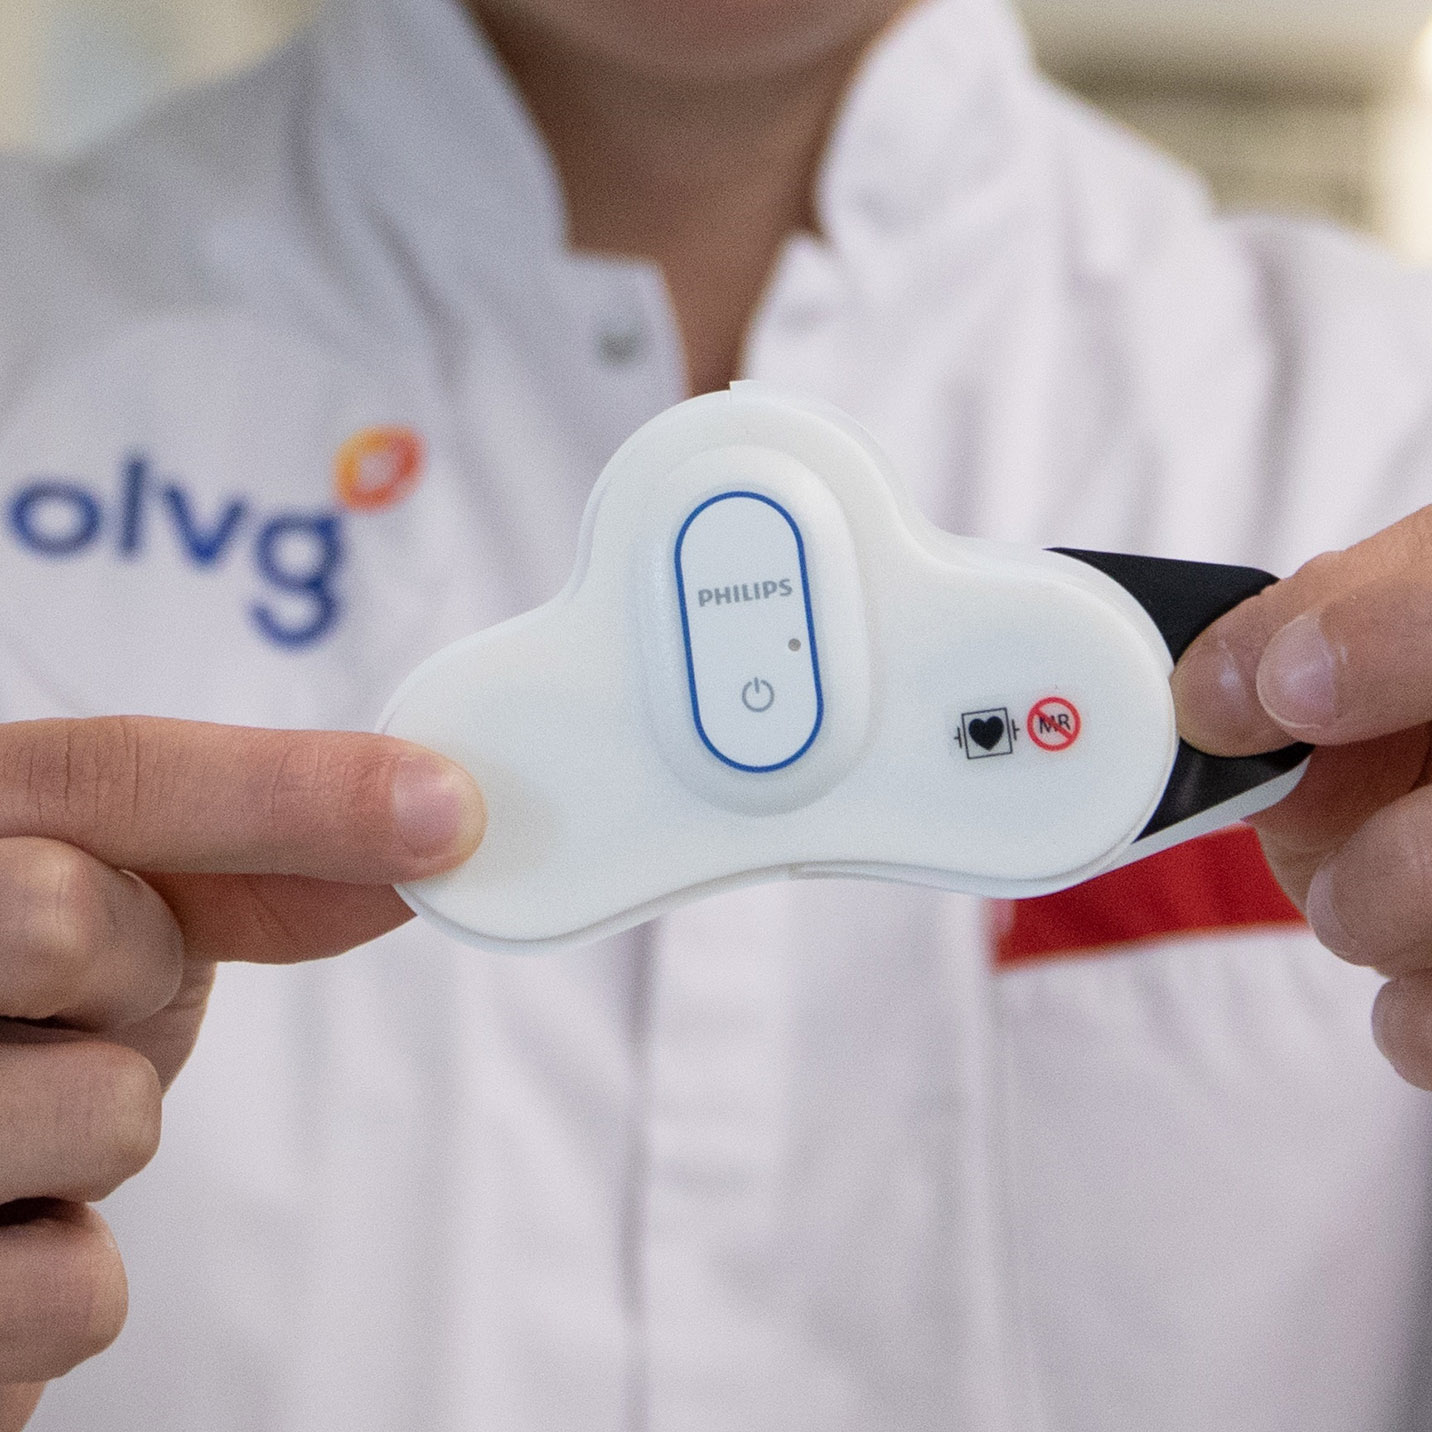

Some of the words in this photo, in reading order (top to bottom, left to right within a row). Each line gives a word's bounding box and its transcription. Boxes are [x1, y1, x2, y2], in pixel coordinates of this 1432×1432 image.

[5, 449, 346, 651] olvg
[698, 578, 793, 607] PHILIPS
[1038, 713, 1071, 734] MR
